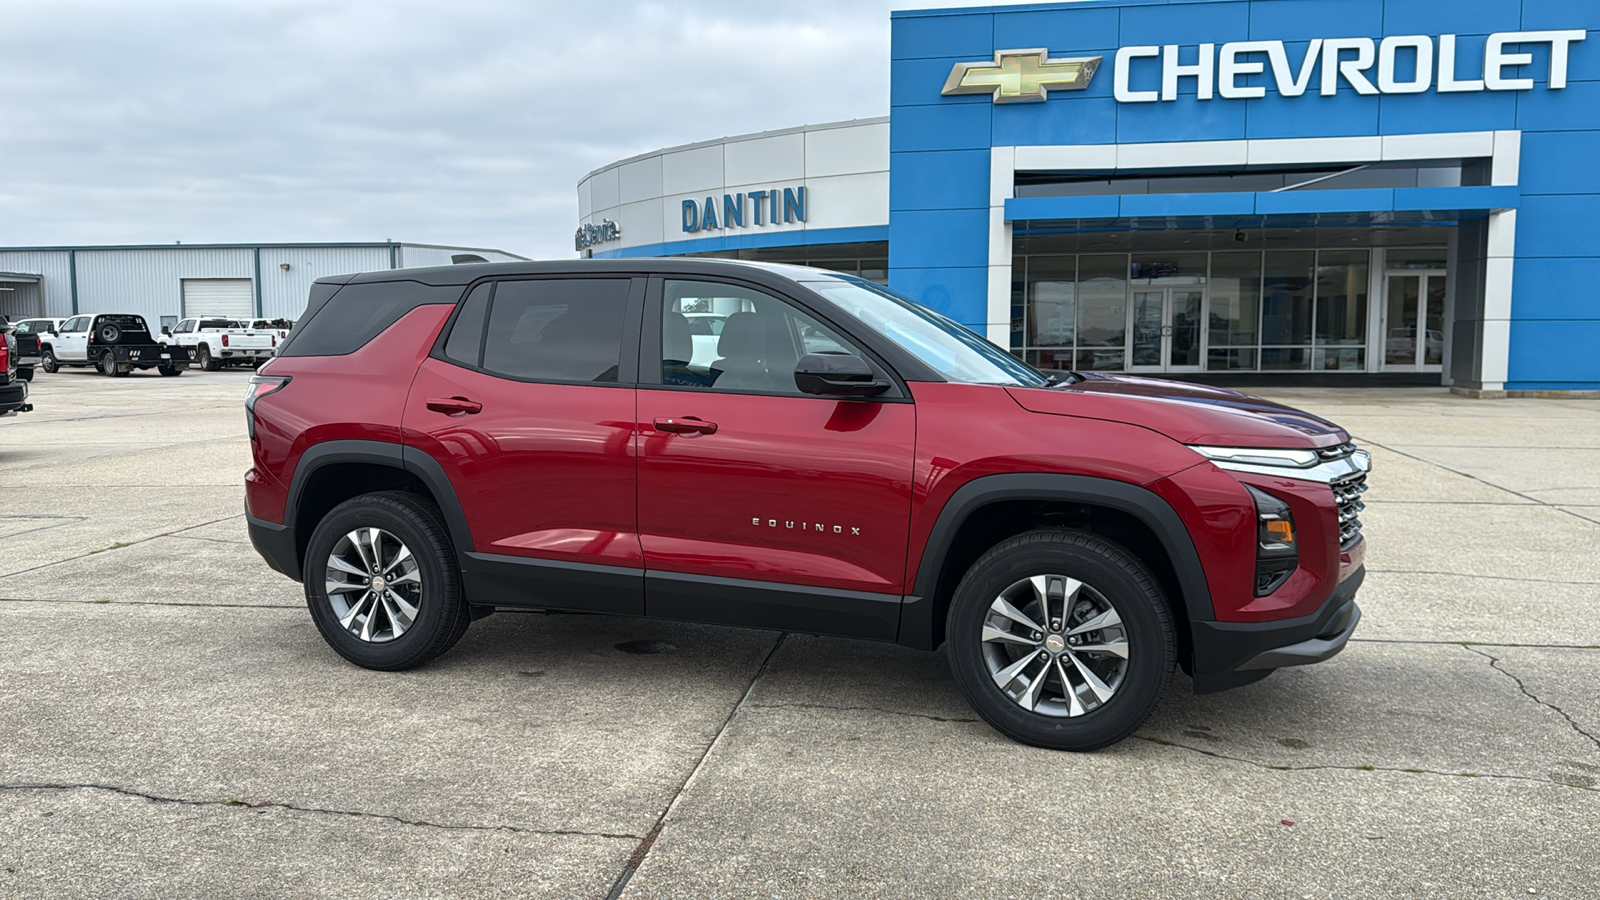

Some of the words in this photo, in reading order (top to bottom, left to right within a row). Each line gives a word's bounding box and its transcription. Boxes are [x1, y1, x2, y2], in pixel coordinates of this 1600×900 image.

[1114, 29, 1587, 102] CHEVROLET
[681, 186, 806, 232] DANTIN
[752, 517, 860, 535] EQUINOX
